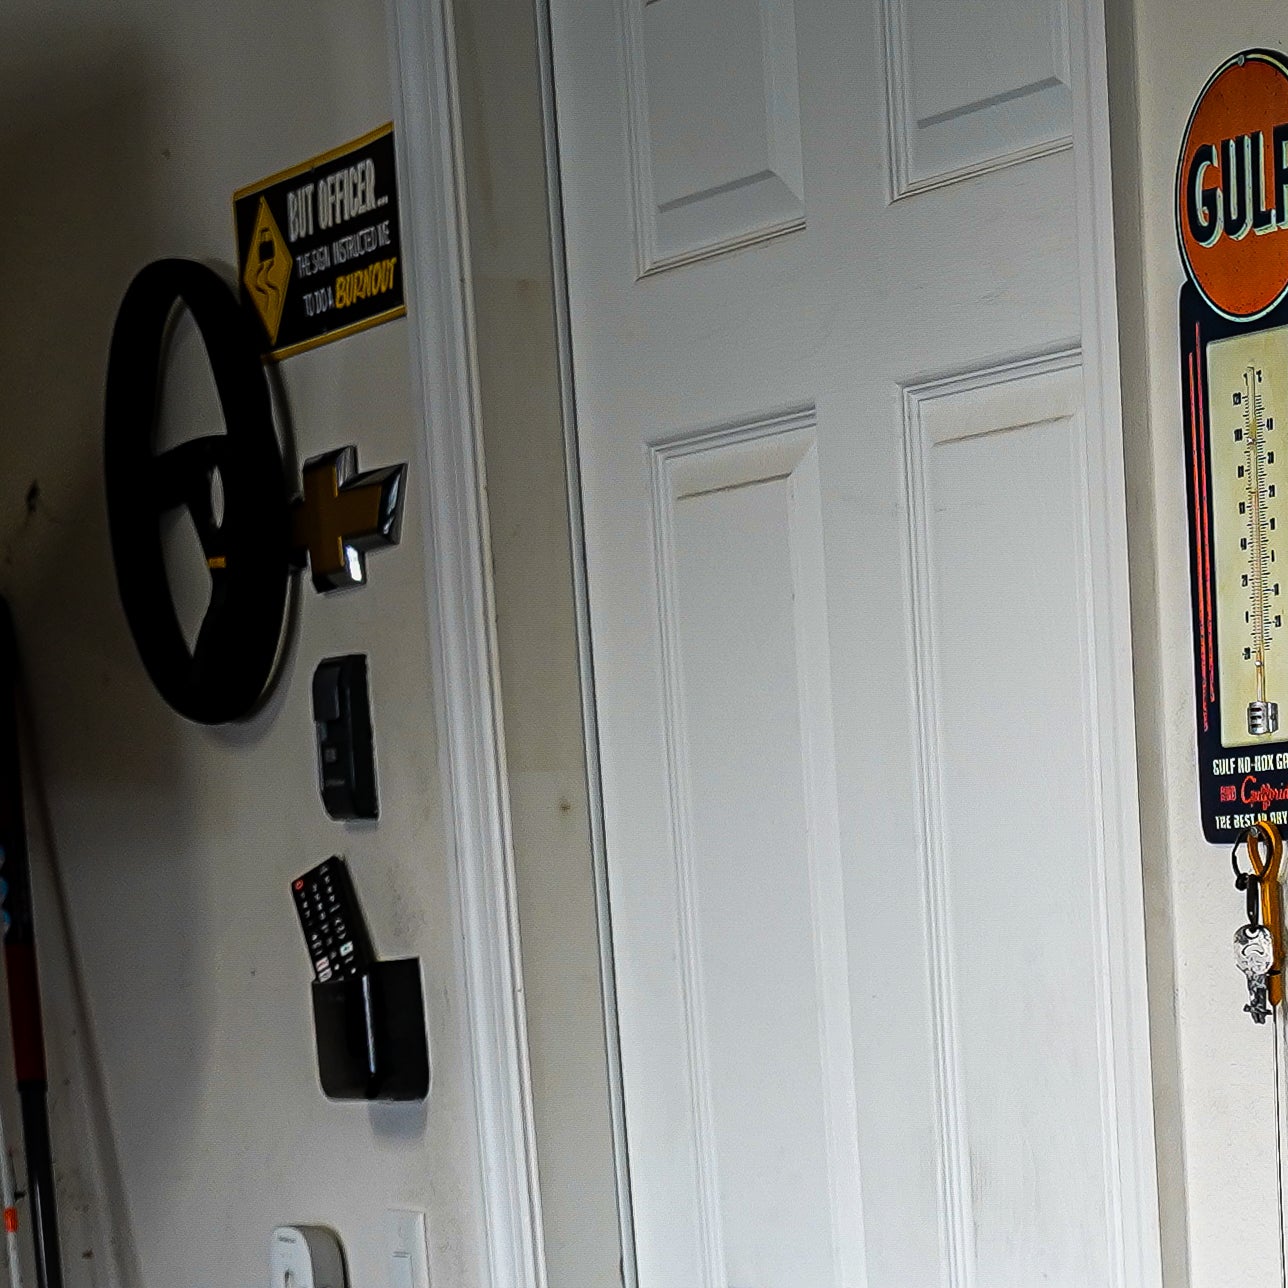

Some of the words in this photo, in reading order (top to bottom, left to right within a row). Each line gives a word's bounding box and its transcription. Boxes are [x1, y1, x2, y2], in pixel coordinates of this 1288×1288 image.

[287, 183, 315, 242] BUT
[296, 254, 310, 279] THE
[310, 245, 331, 274] SIGN
[335, 257, 397, 309] BURNOUT
[1212, 759, 1236, 776] GULF
[1233, 813, 1255, 828] BEST
